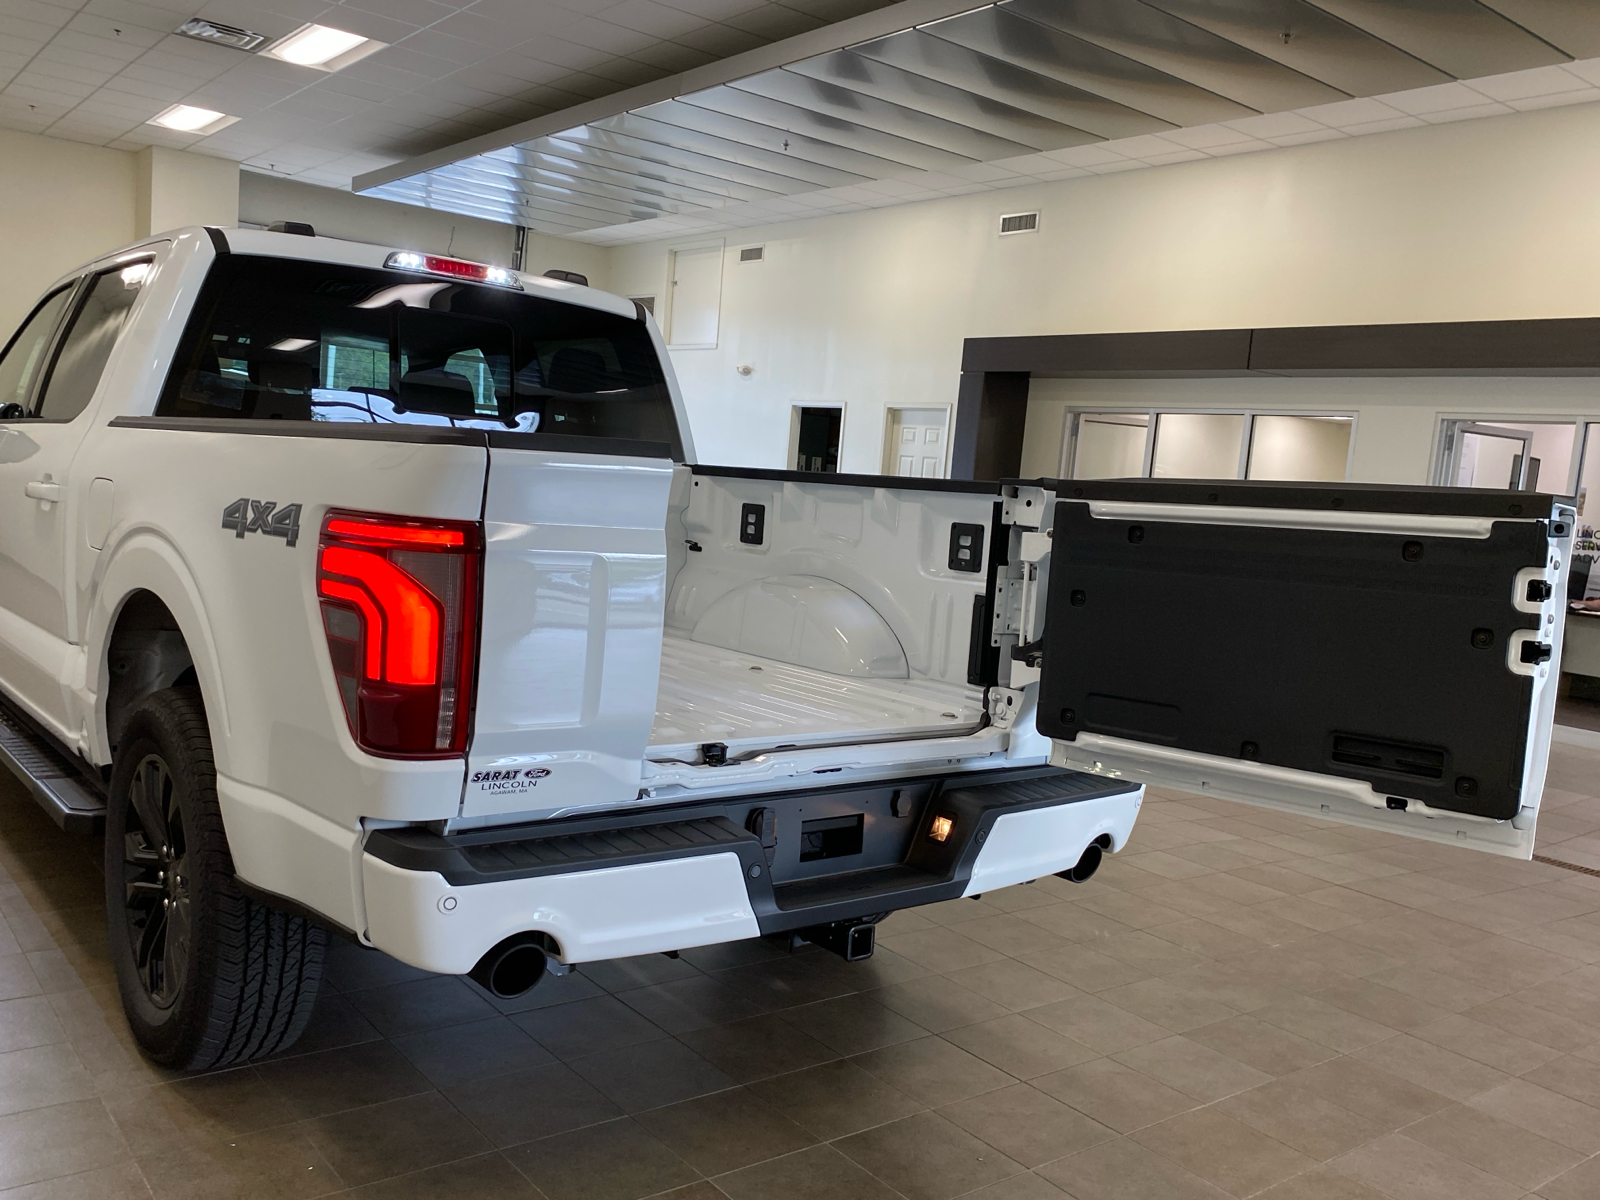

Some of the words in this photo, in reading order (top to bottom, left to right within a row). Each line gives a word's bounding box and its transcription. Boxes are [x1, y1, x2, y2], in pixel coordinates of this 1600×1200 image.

[471, 769, 522, 783] SARAT
[527, 769, 549, 778] Ford
[481, 780, 538, 791] LINCOLN
